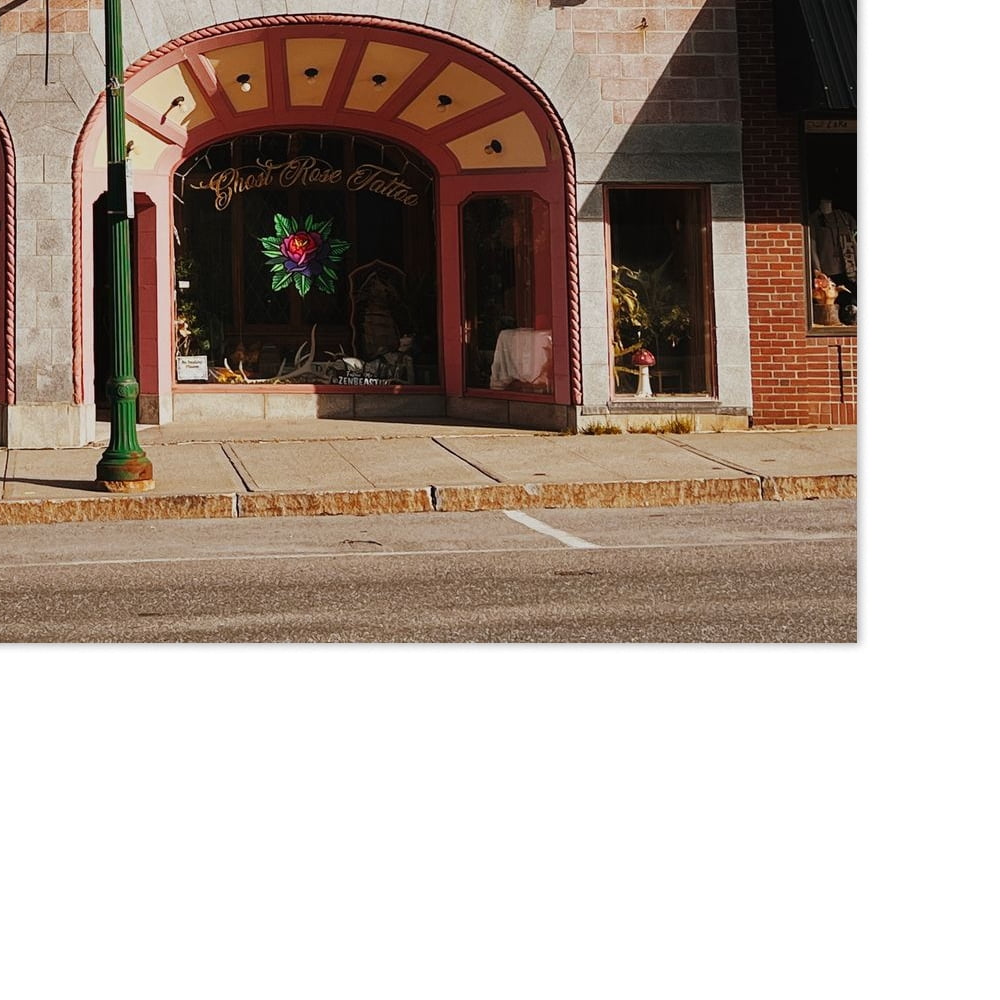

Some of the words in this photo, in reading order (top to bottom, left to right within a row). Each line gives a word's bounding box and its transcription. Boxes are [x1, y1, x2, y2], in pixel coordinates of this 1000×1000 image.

[190, 164, 274, 211] Ghost
[257, 156, 343, 188] Rose
[347, 163, 420, 207] Tattoo
